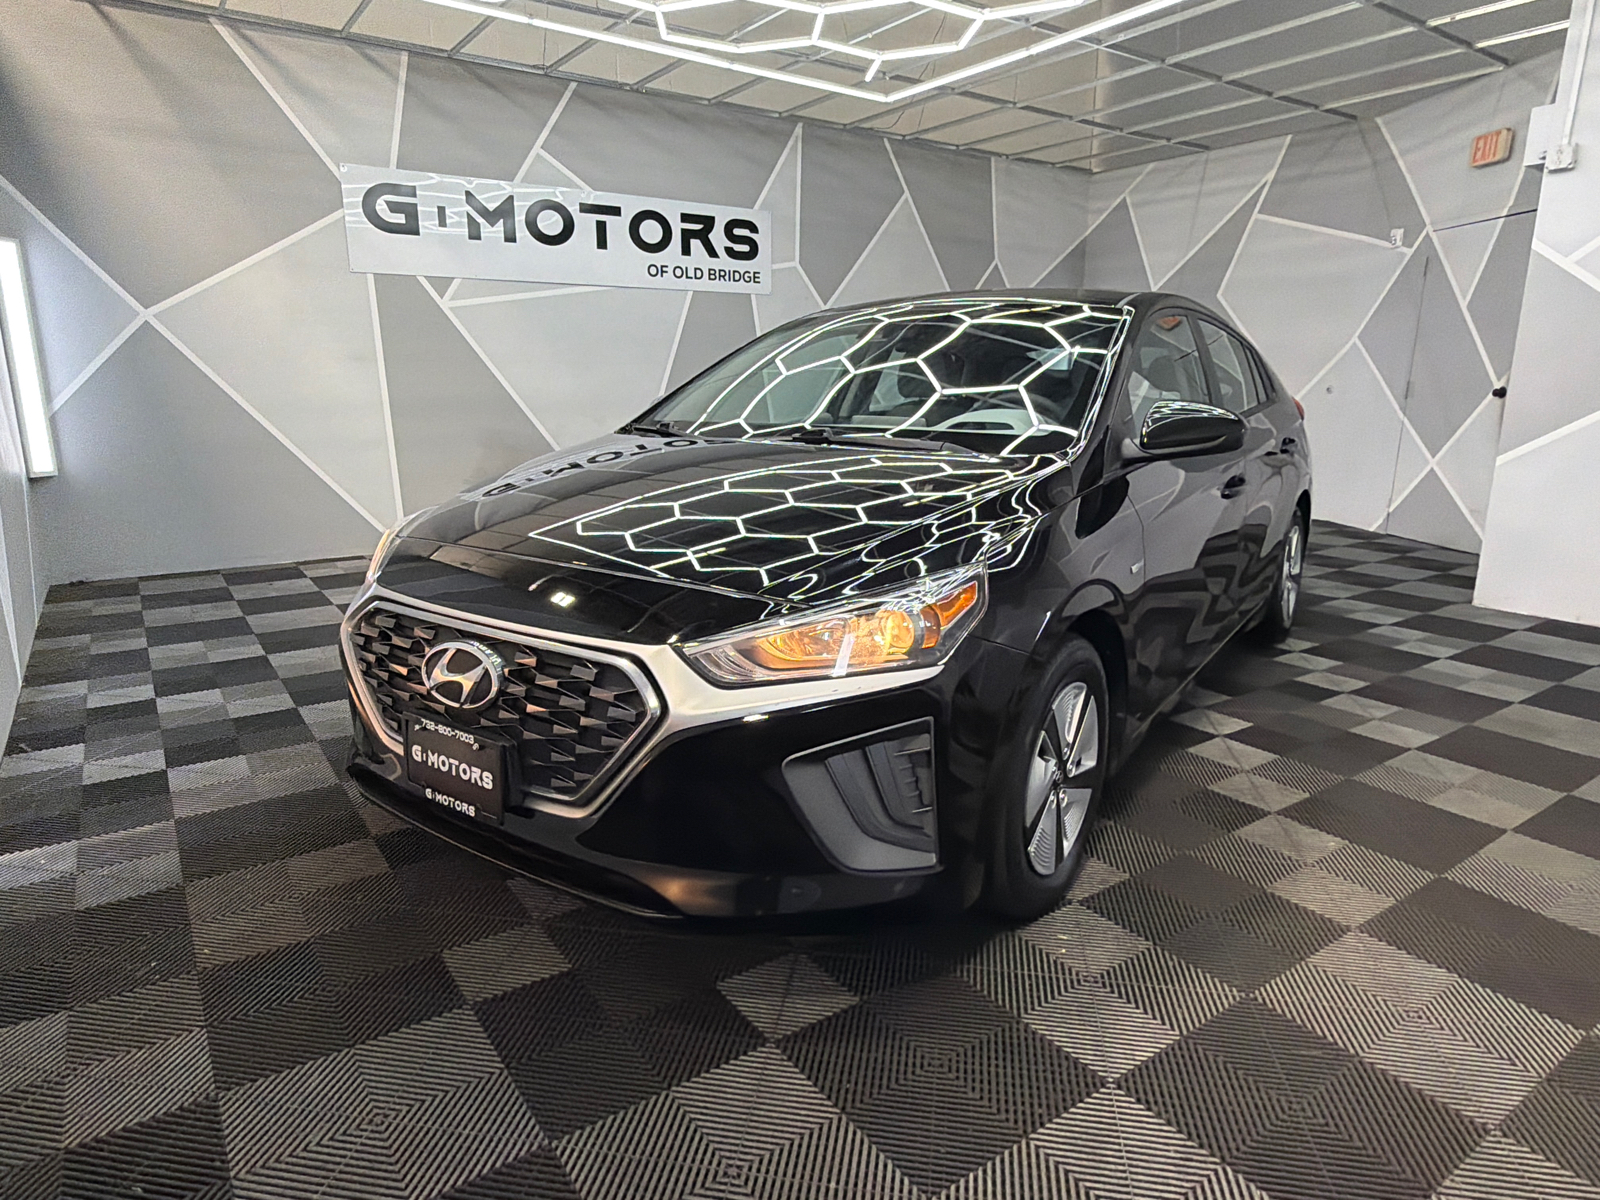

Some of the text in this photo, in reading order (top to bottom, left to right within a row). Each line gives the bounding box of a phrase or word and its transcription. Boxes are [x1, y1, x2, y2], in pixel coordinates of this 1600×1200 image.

[1473, 130, 1502, 164] EXIT
[647, 263, 761, 284] OF OLD BRIDGE
[420, 718, 475, 745] 732-800-7003
